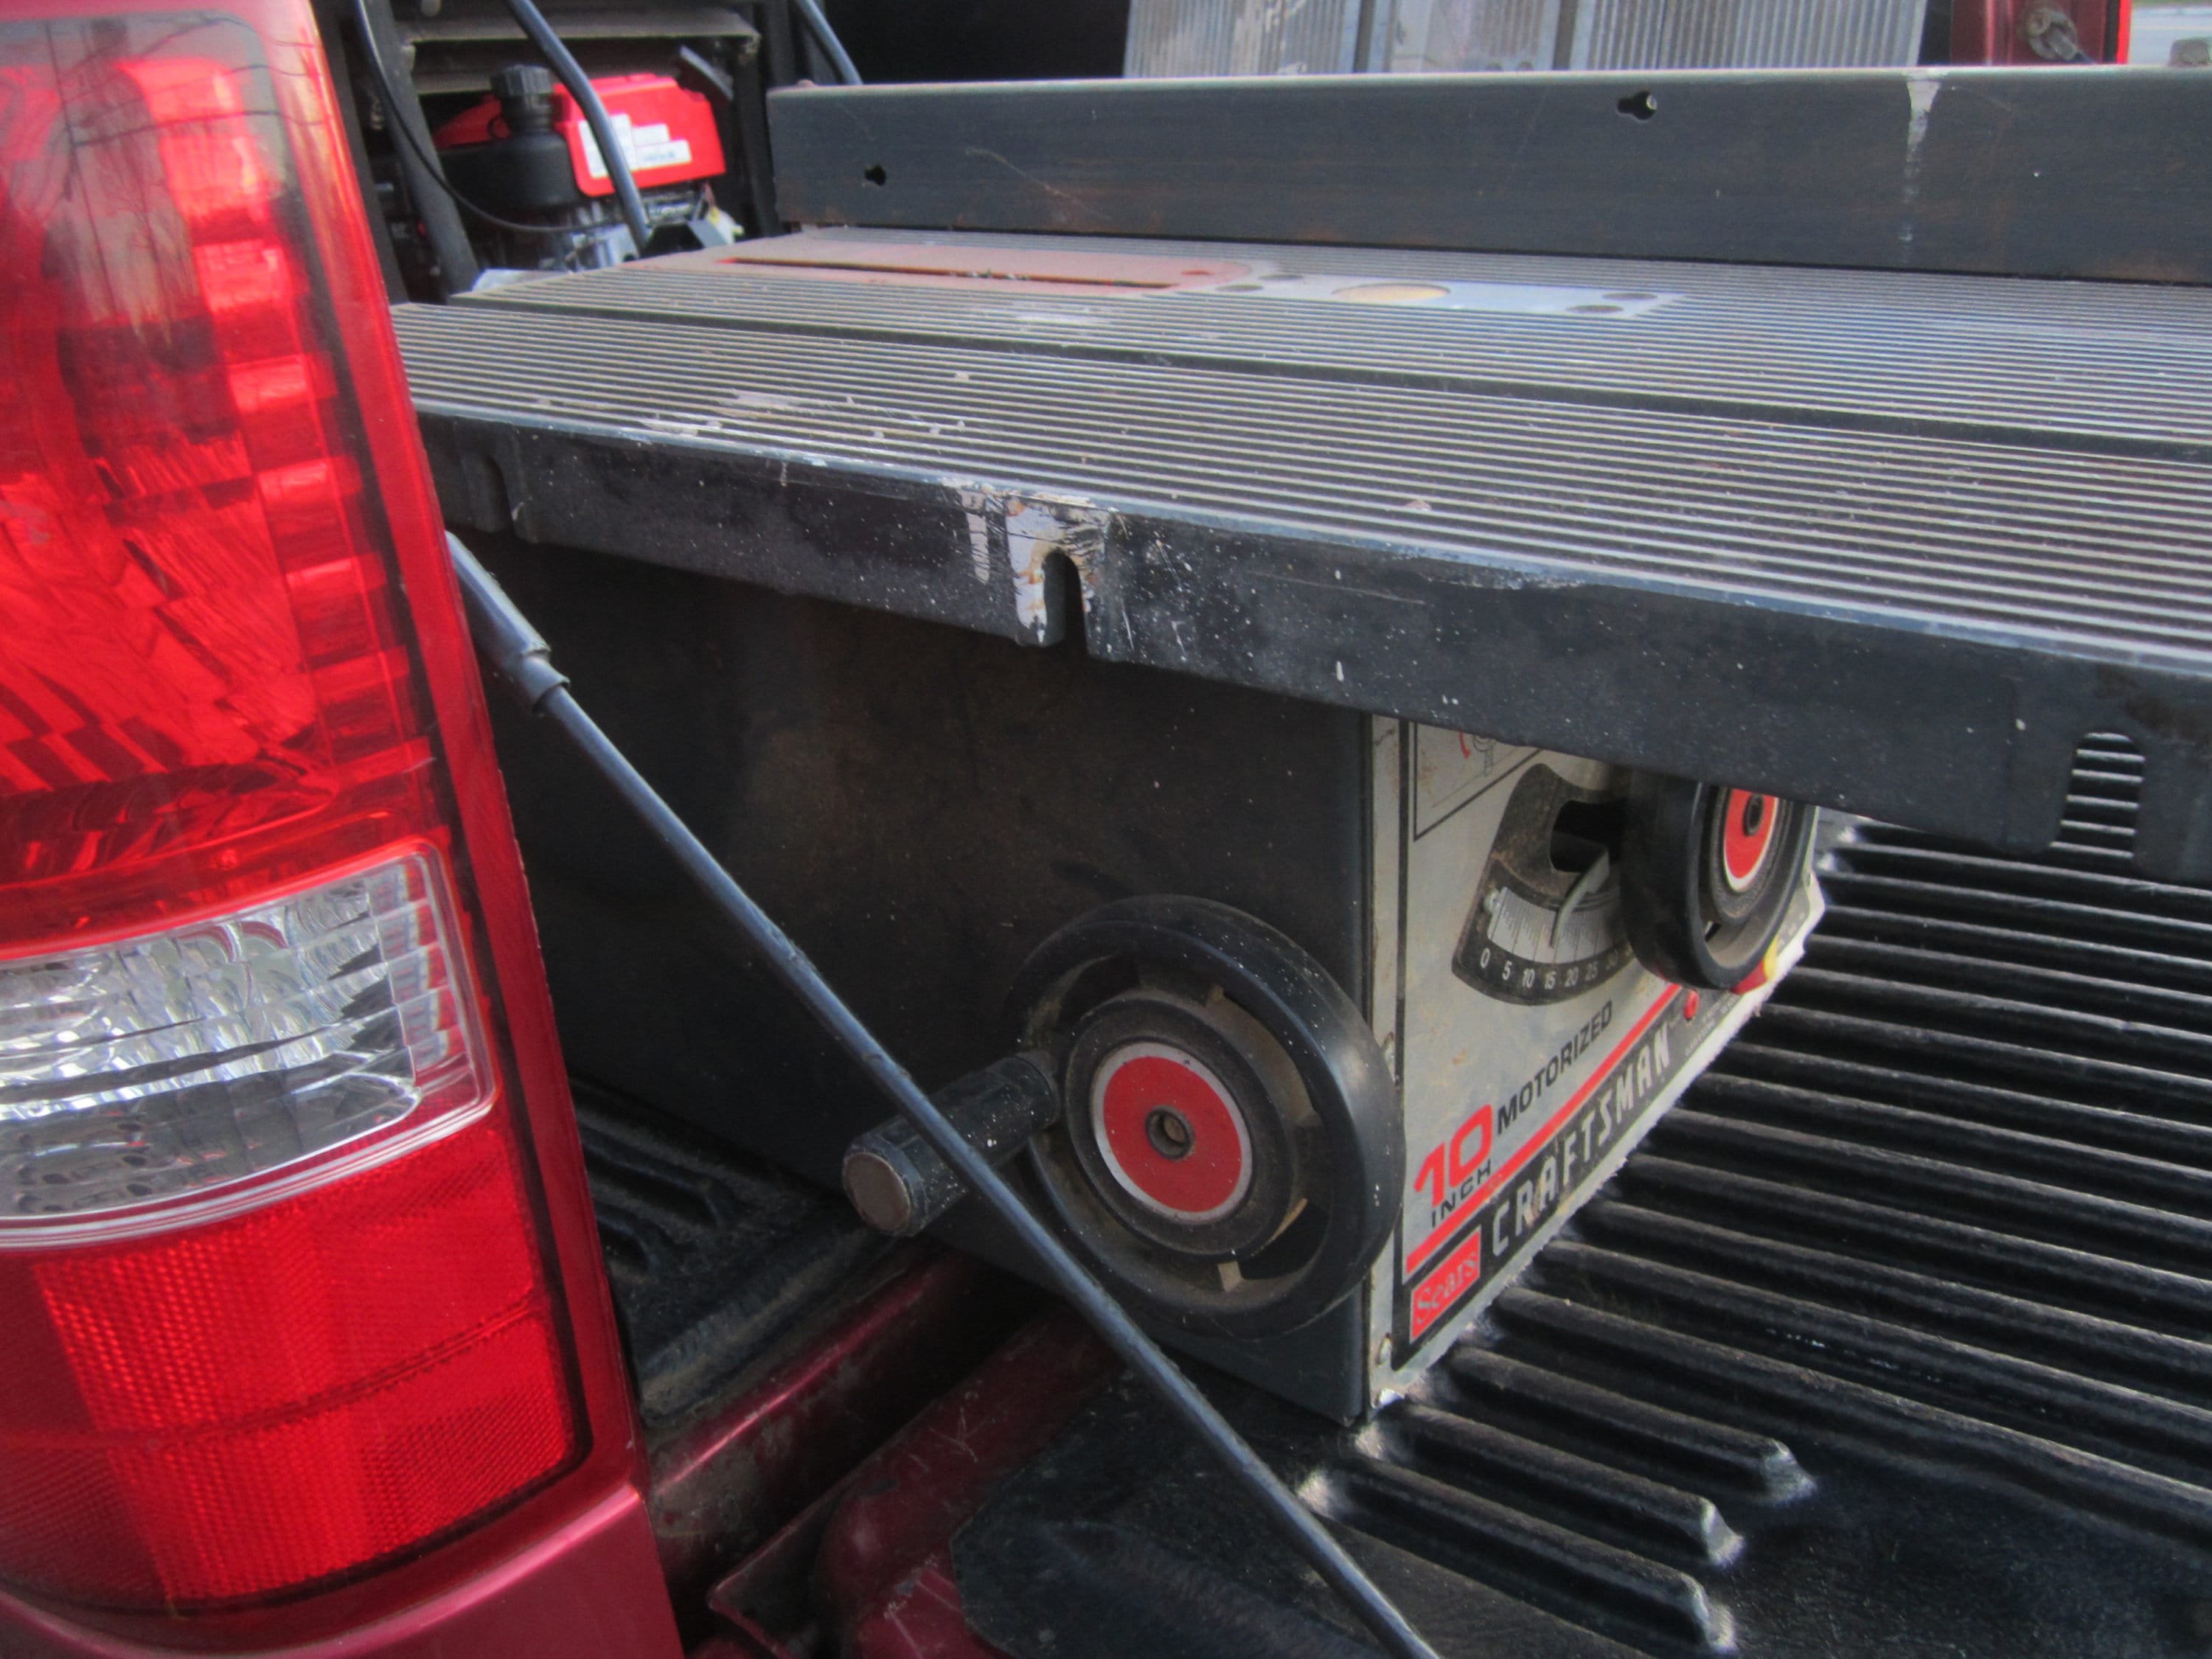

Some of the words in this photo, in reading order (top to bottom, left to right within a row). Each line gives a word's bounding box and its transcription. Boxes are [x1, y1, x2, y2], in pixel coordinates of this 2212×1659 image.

[1480, 947, 1491, 969] 0
[1502, 960, 1512, 981] 5
[1521, 967, 1535, 989] 10
[1544, 970, 1557, 990] 15
[1564, 966, 1579, 987] 20
[1413, 1103, 1493, 1208] 10
[1497, 1000, 1613, 1136] MOTORIZED
[1416, 1253, 1478, 1326] Sears
[1492, 1020, 1671, 1257] CRAFTSMAN
[1431, 1158, 1492, 1229] INCH
